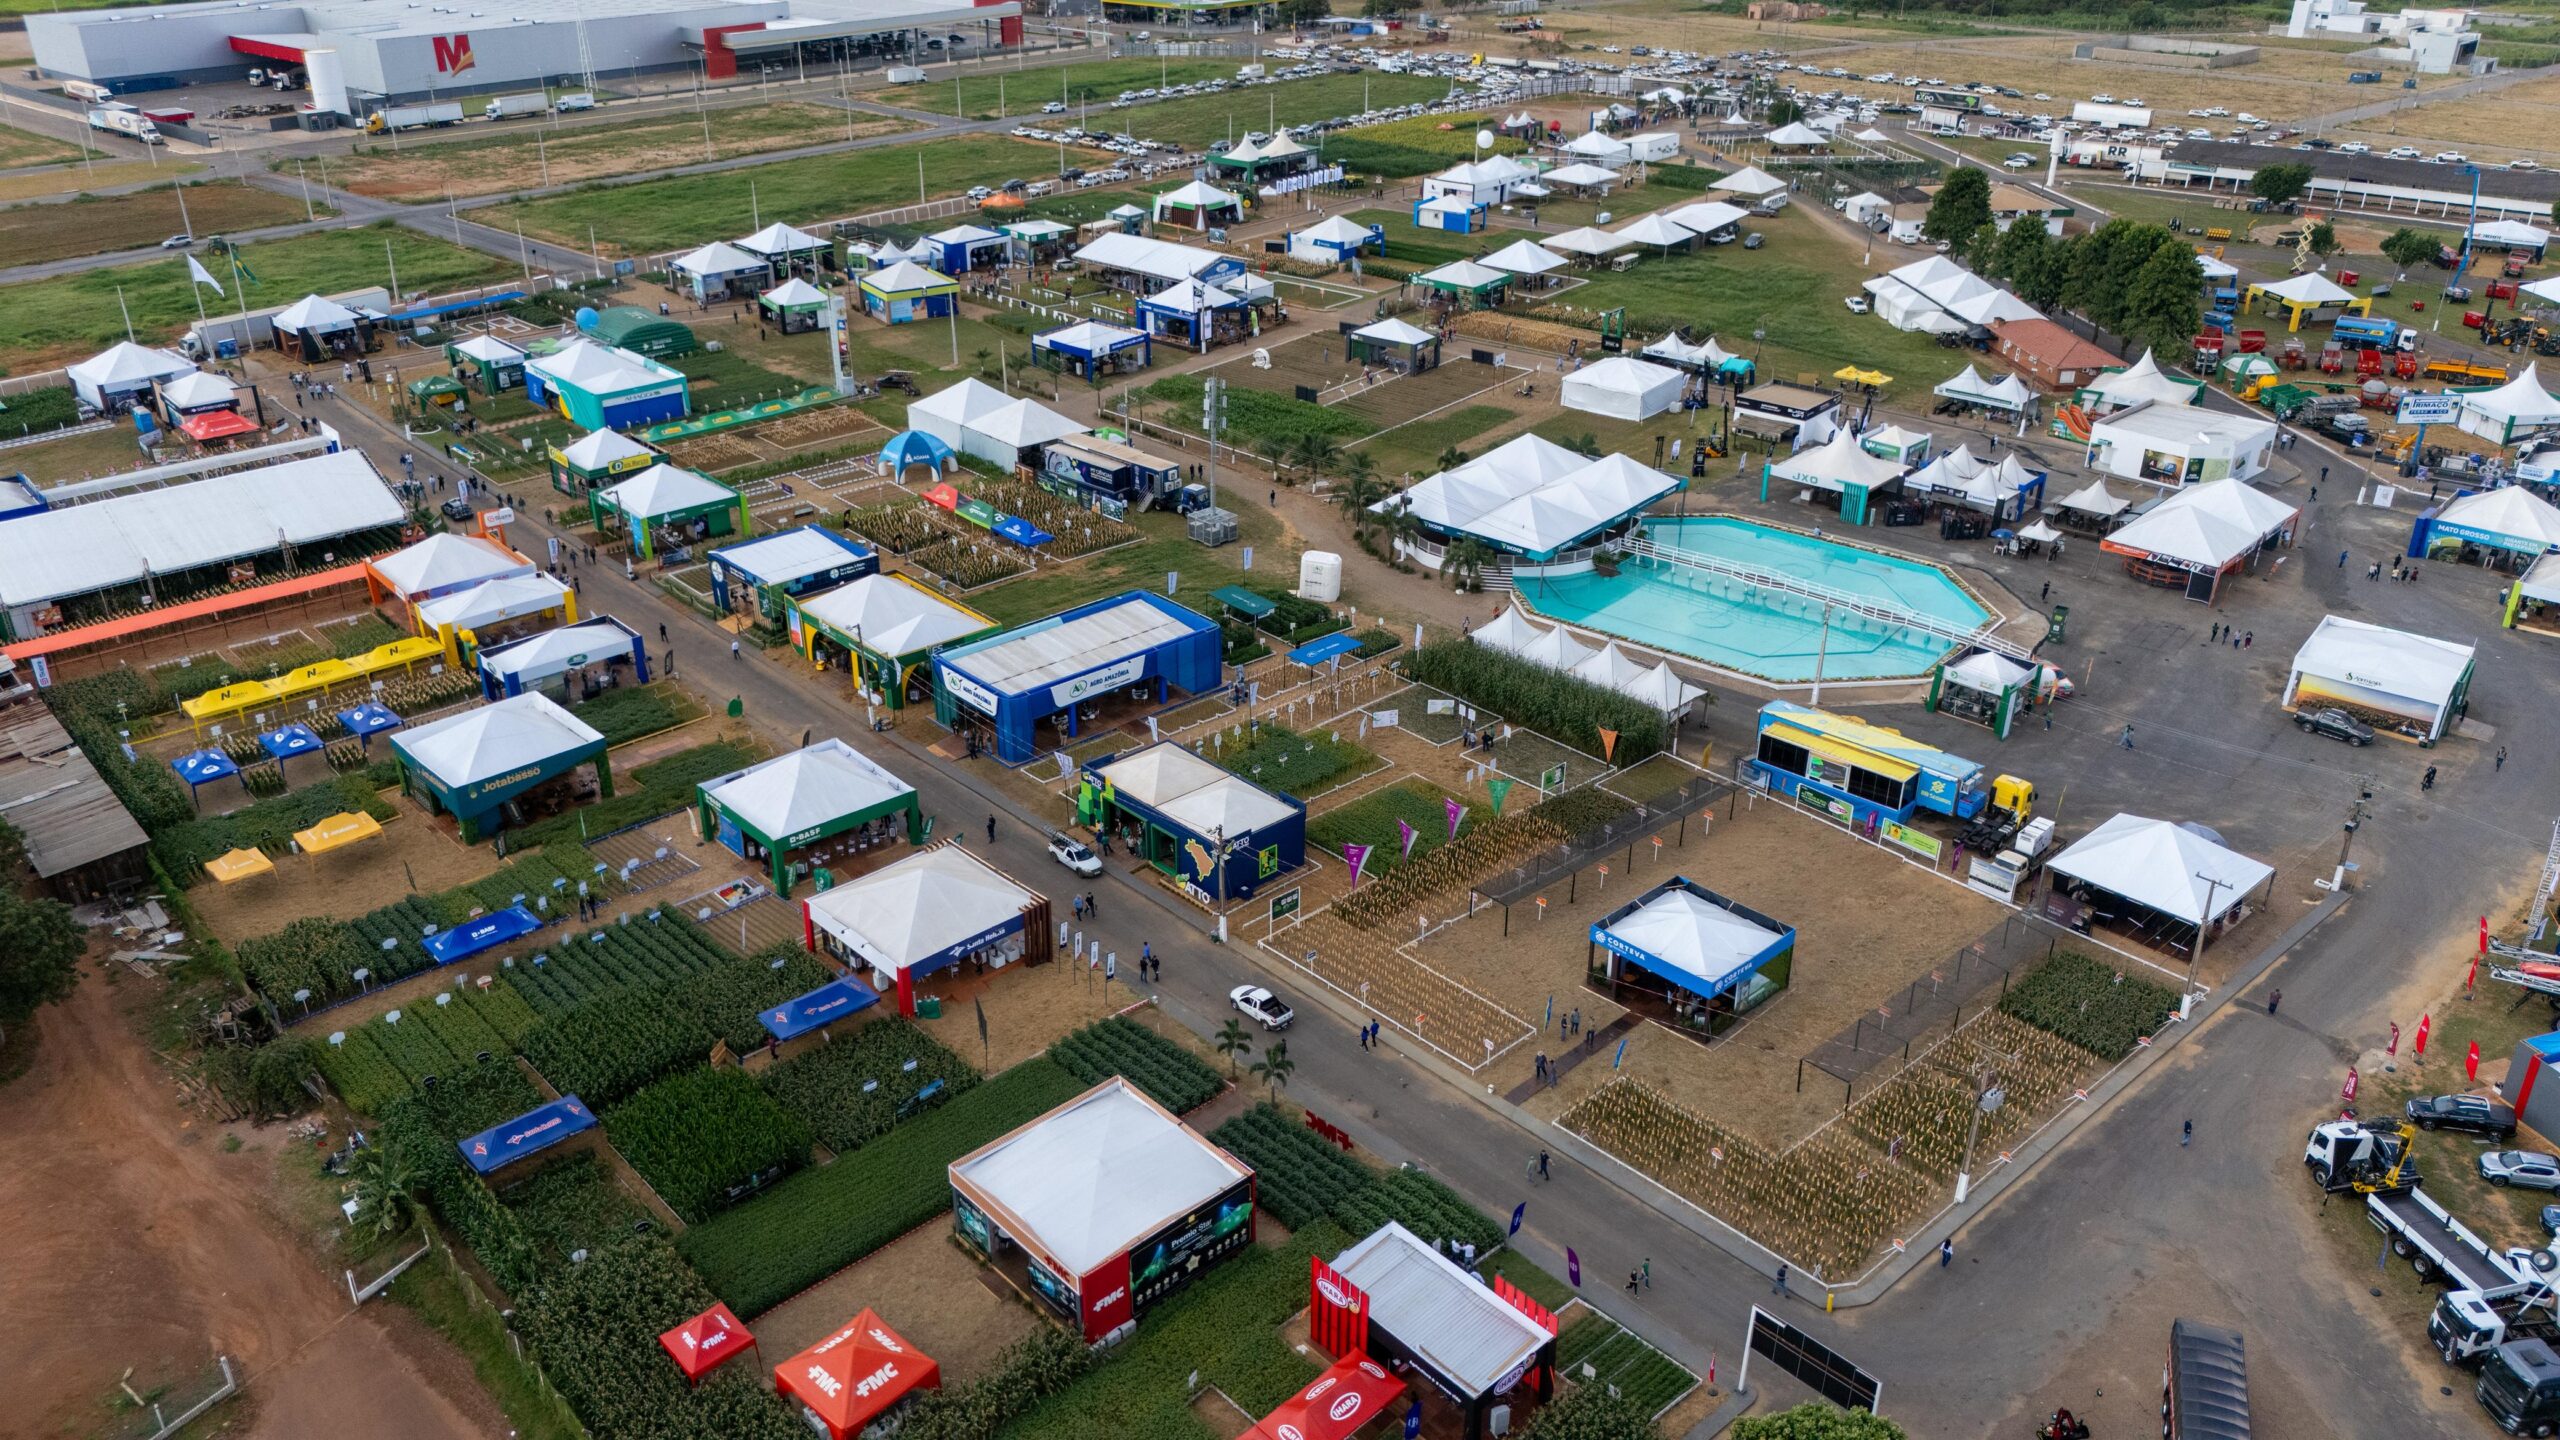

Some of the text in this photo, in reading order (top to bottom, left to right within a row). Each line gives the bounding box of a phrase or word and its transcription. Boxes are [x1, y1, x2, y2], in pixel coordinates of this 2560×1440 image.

[432, 36, 475, 74] M
[2107, 146, 2128, 157] RR
[2412, 398, 2449, 409] TRIMAÇO
[2438, 524, 2490, 541] MATO GROSSO
[1089, 669, 1130, 687] AGRO AMAZÔNIA
[962, 686, 973, 696] AGRO
[481, 766, 542, 794] Jotabasso
[1088, 775, 1102, 788] ATTO
[799, 827, 822, 842] BASF
[1233, 836, 1250, 850] ATTO
[1184, 881, 1211, 905] ATTO
[966, 938, 985, 950] Santa
[1607, 937, 1646, 961] CORTEVA
[1724, 962, 1753, 984] CORTEVA
[1198, 1218, 1213, 1232] Star
[1044, 1254, 1071, 1285] FMC
[1093, 1285, 1125, 1313] FMC
[1319, 1281, 1345, 1304] IHARA
[701, 1331, 728, 1350] FMC
[813, 1328, 856, 1354] FMC
[868, 1328, 904, 1353] FMC
[808, 1364, 843, 1398] FMC
[856, 1362, 900, 1397] FMC
[1497, 1369, 1524, 1392] IHARA
[1332, 1395, 1359, 1419] IHARA
